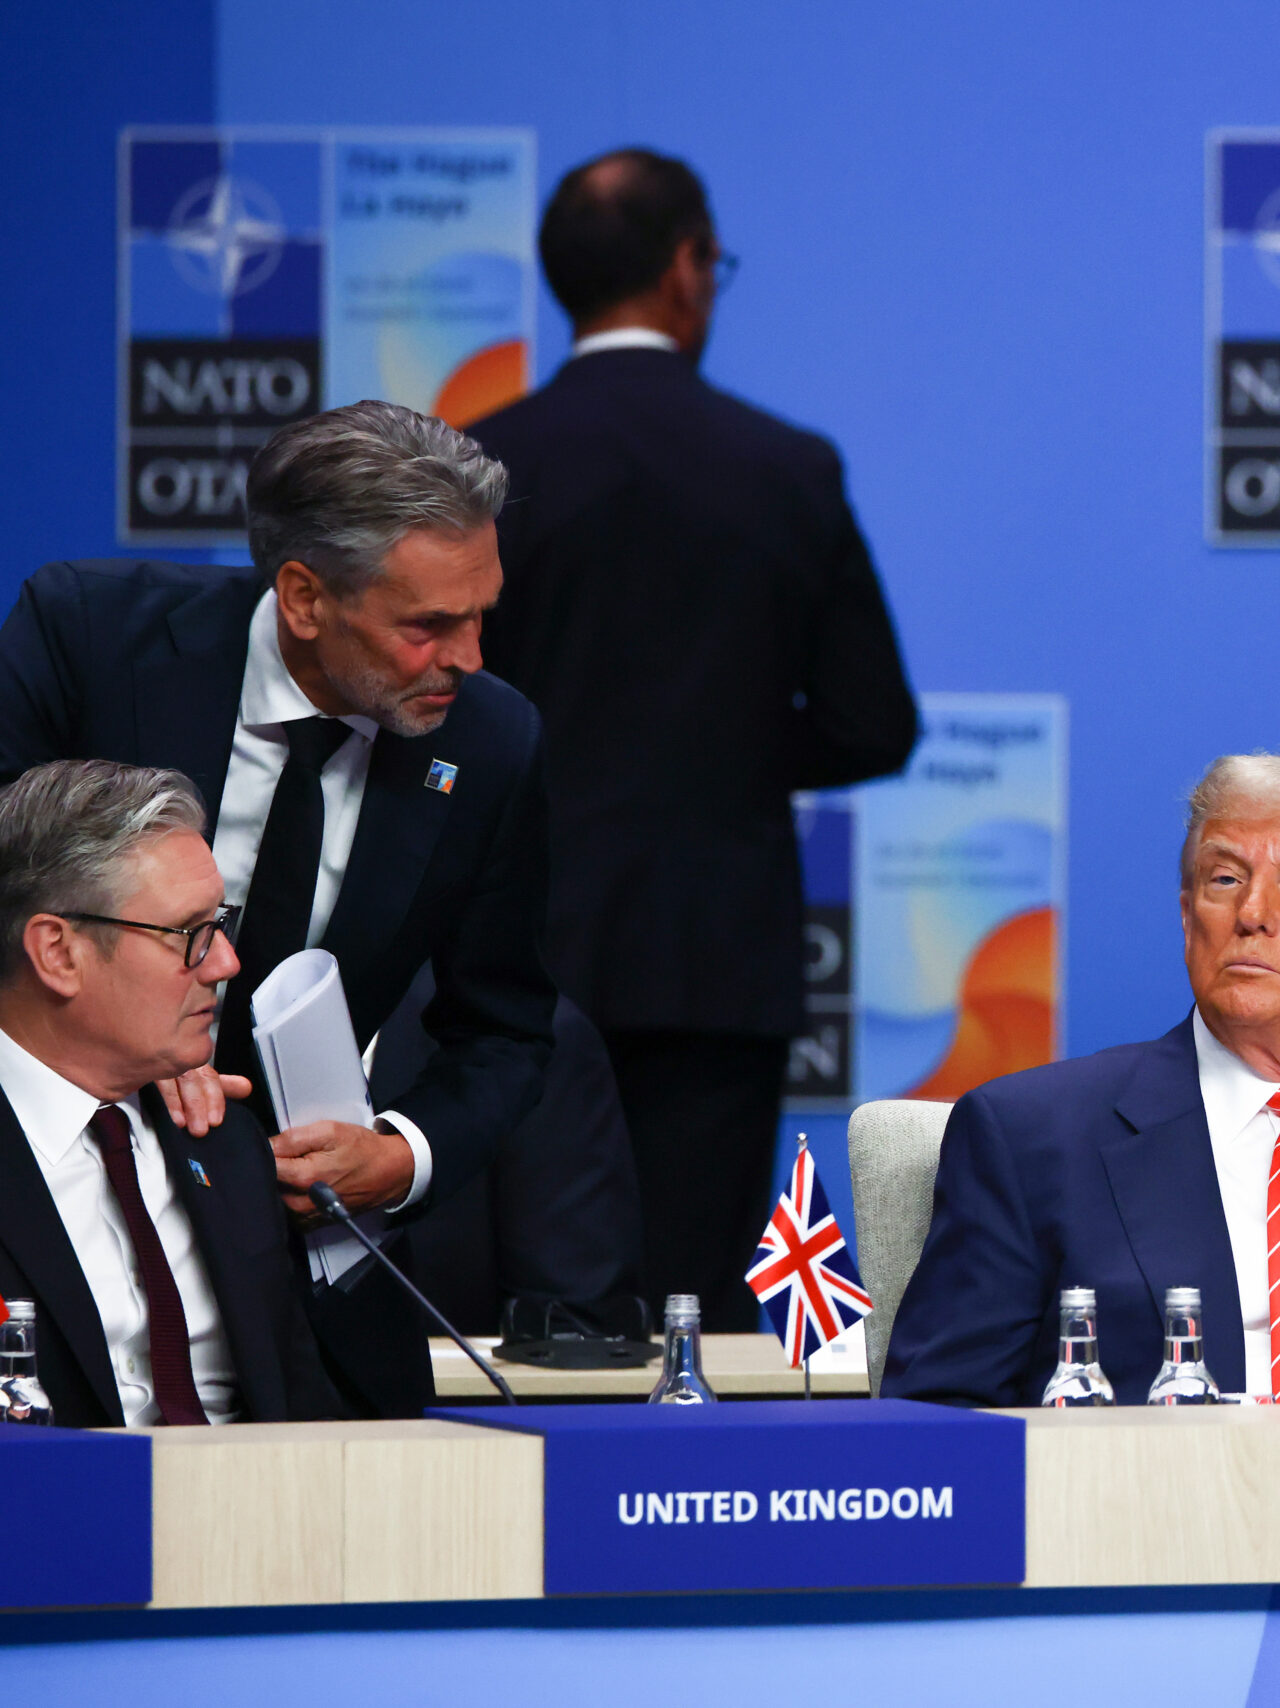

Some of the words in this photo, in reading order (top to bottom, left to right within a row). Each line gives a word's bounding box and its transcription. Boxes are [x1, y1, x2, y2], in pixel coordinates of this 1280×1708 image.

[142, 358, 310, 414] NATO
[137, 457, 248, 515] OTA
[618, 1490, 758, 1524] UNITED
[769, 1487, 953, 1522] KINGDOM
